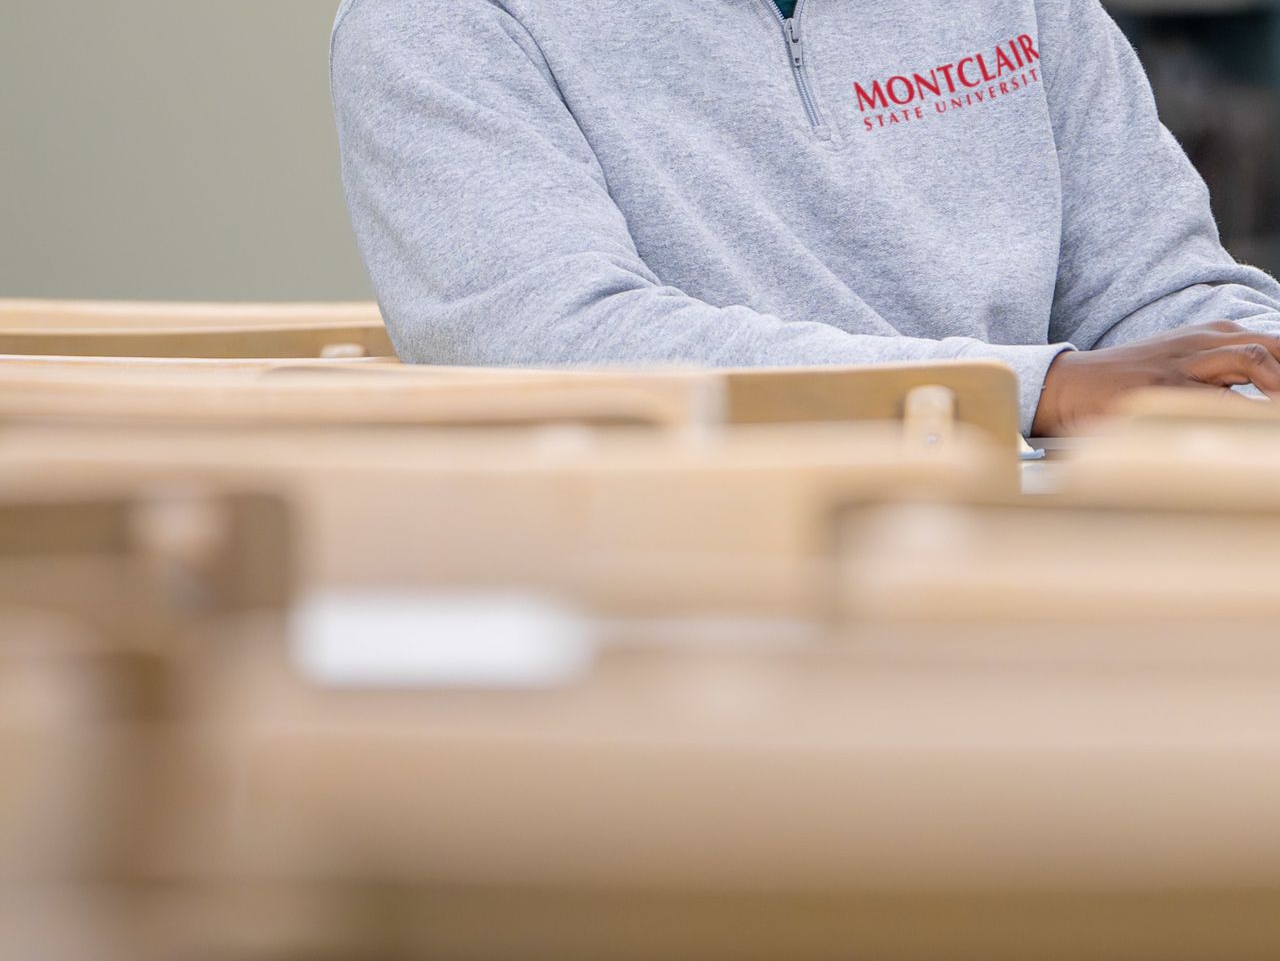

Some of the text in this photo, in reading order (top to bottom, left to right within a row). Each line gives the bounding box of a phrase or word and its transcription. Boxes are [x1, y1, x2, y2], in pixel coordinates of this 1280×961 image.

[853, 34, 1039, 112] MONTCLAIR
[863, 68, 1038, 132] STATE UNIVERSIT
